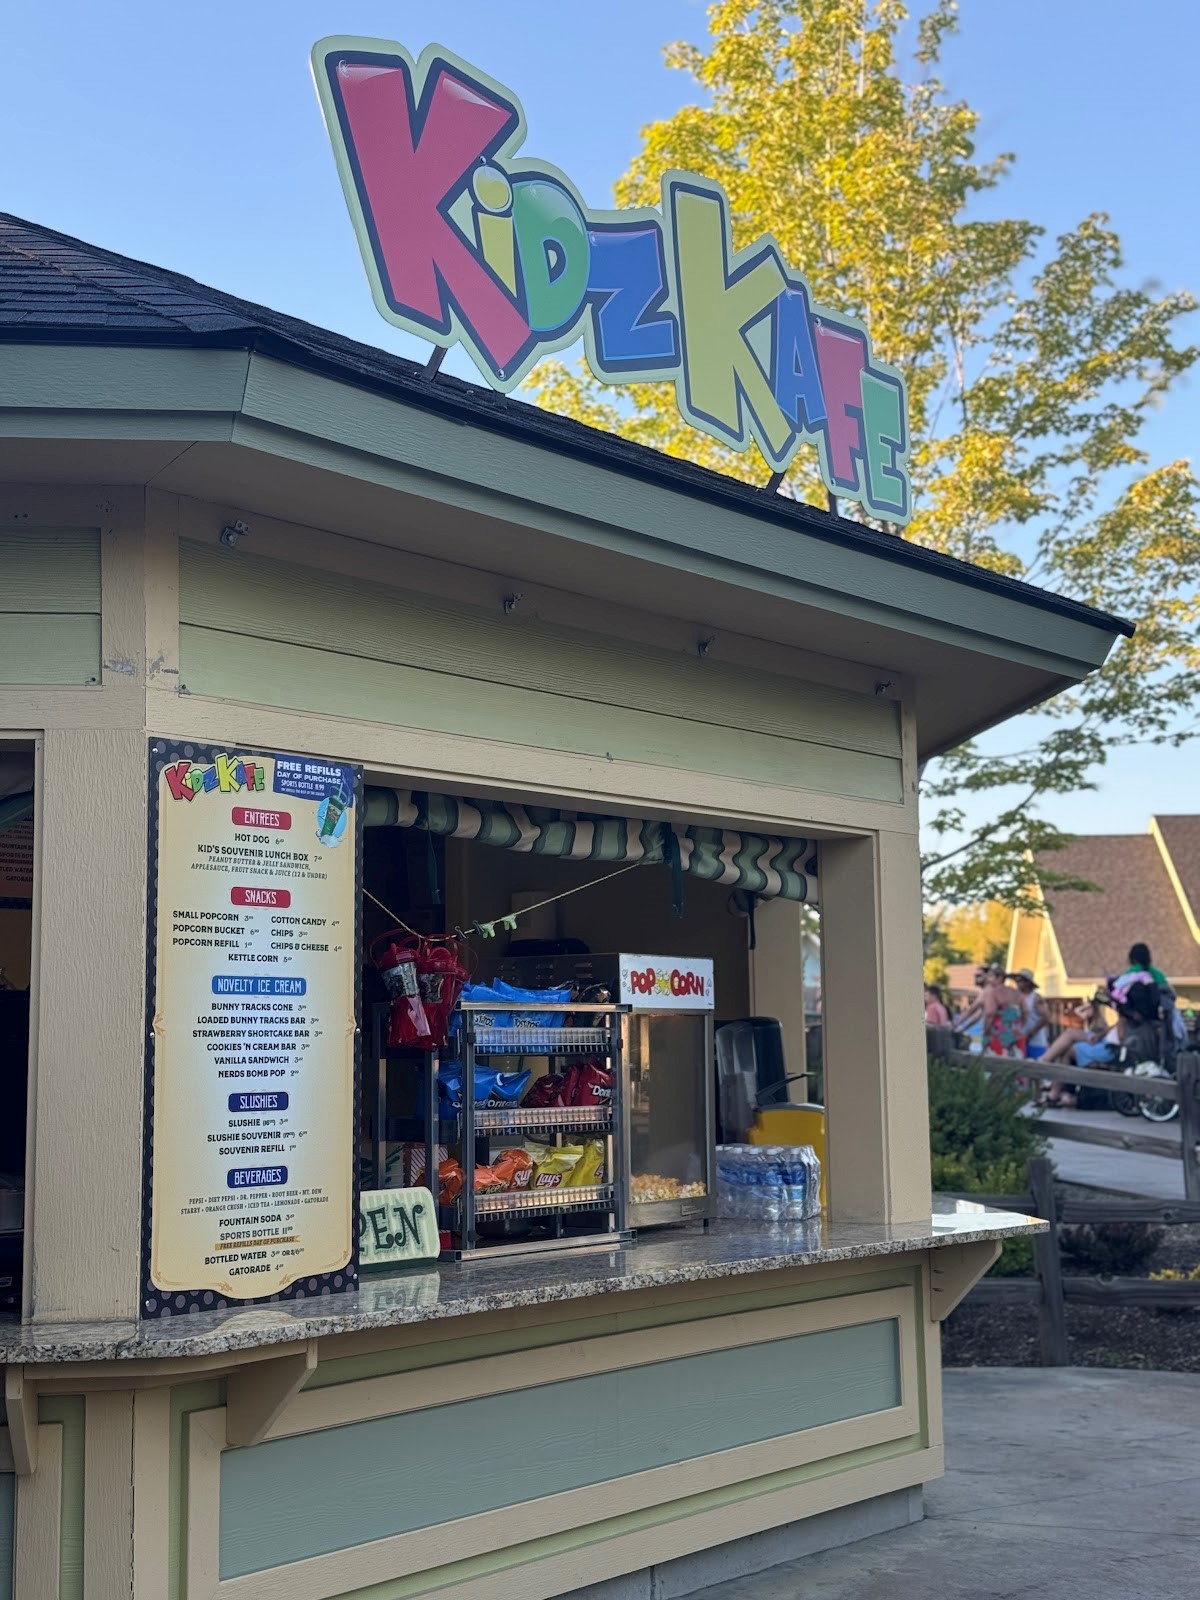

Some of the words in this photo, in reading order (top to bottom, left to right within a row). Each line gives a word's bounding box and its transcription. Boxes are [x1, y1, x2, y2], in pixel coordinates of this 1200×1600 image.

[277, 761, 301, 771] FREE
[305, 765, 341, 776] REFILLS
[281, 779, 297, 787] SPORTS
[304, 775, 341, 784] PURCHASE
[244, 810, 280, 826] ENTREES
[235, 833, 250, 842] HOT
[253, 835, 270, 844] DOG
[197, 844, 219, 854] KID'S
[221, 847, 263, 857] SOUVENIR
[265, 850, 291, 860] LUNCH
[293, 853, 309, 861] BOX
[191, 863, 230, 873] APPLESAUCE,
[249, 867, 268, 875] SNACK
[233, 857, 255, 865] BUTTER
[280, 862, 311, 871] SANDWICH,
[245, 890, 276, 904] SNACKS
[172, 911, 199, 920] SMALL
[200, 912, 239, 921] POPCORN
[271, 916, 300, 925] COTTON
[302, 917, 327, 926] CANDY
[172, 924, 213, 933] POPCORN
[214, 926, 245, 935] BUCKET
[271, 929, 294, 937] CHIPS
[172, 937, 213, 946] POPCORN
[214, 939, 239, 948] REFILL
[271, 942, 294, 950] CHIPS
[302, 943, 329, 951] CHEESE
[257, 954, 279, 962] CORN
[217, 978, 253, 992] NOVELTY
[258, 979, 271, 992] ICE
[274, 980, 302, 993] CREAM
[630, 968, 656, 995] POP
[670, 969, 704, 996] CORN
[211, 1003, 240, 1011] BUNNY
[241, 1003, 271, 1011] TRACKS
[272, 1003, 293, 1011] CONE
[197, 1016, 229, 1024] LOADED
[230, 1016, 258, 1024] BUNNY
[207, 1043, 242, 1051] COOKIES
[252, 1043, 280, 1051] CREAM
[248, 1056, 289, 1064] SANDWICH
[218, 1070, 245, 1078] NERDS
[270, 1069, 286, 1077] POP
[240, 1095, 278, 1109] SLUSHIES
[228, 1119, 260, 1127] SLUSHIE
[207, 1134, 240, 1142] SLUSHIE
[241, 1131, 281, 1141] SOUVENIR
[219, 1146, 260, 1155] SOUVENIR
[261, 1145, 285, 1153] REFILL
[234, 1169, 282, 1185] BEVERAGES
[537, 1173, 561, 1188] Lay's
[180, 1207, 201, 1215] STARRY
[219, 1217, 259, 1227] FOUNTAIN
[260, 1214, 282, 1223] SODA
[220, 1231, 250, 1241] SPORTS
[252, 1228, 280, 1237] BOTTLE
[233, 1240, 252, 1248] REFILLS
[271, 1236, 295, 1244] PURCHASE
[204, 1254, 239, 1265] BOTTLED
[240, 1251, 267, 1261] WATER
[229, 1264, 271, 1276] GATORADE
